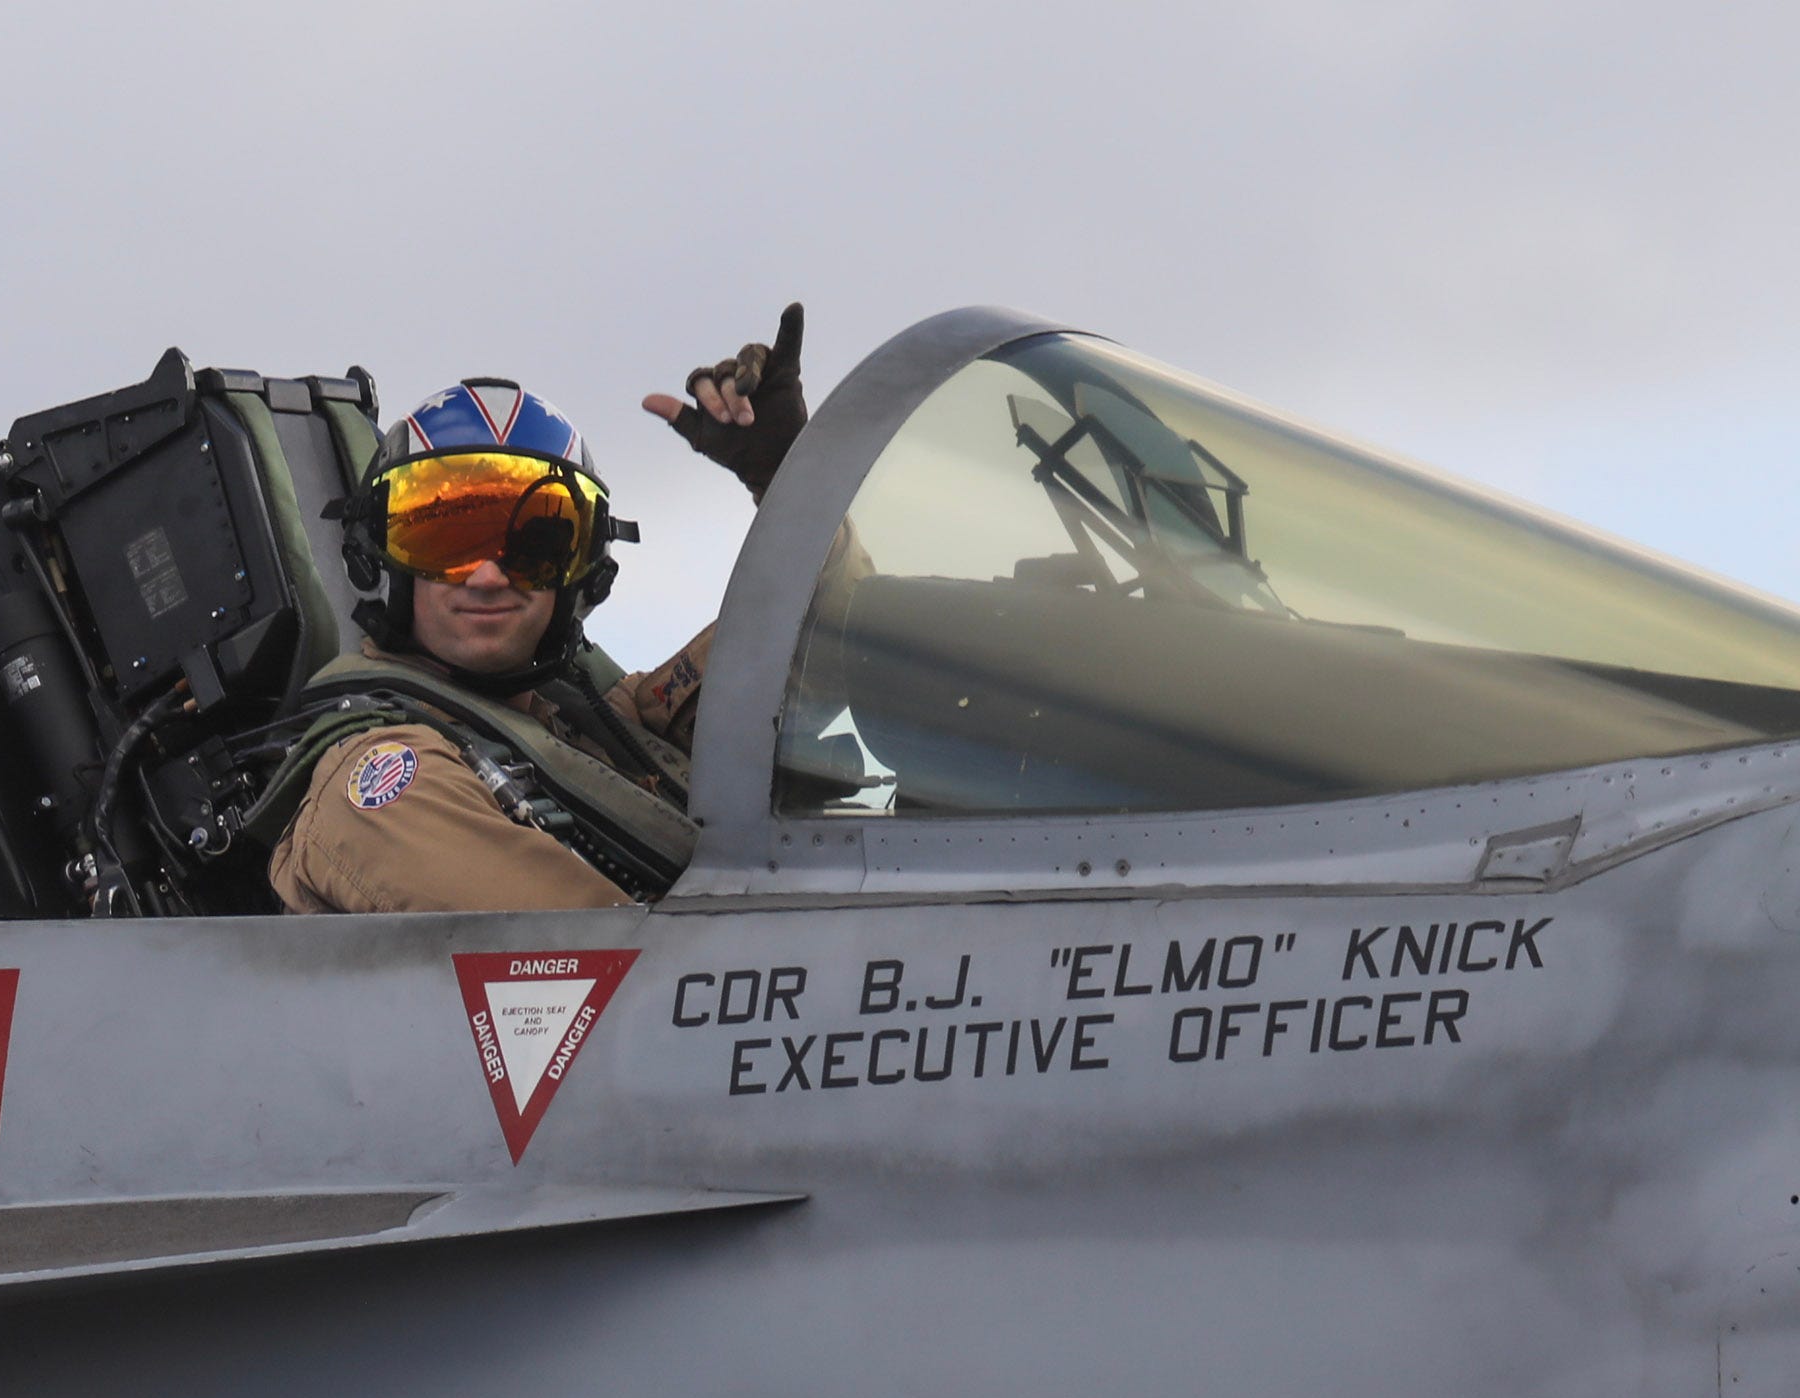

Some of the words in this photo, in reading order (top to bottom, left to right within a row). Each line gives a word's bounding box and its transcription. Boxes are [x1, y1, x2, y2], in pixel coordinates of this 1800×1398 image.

[509, 958, 579, 975] DANGER
[672, 966, 806, 1028] CDR
[859, 955, 983, 1015] B.J.
[1050, 933, 1296, 1000] "ELMO"
[1342, 918, 1555, 981] KNICK
[502, 1007, 543, 1016] EJECTION
[546, 1006, 567, 1015] SEAT
[514, 1027, 550, 1037] CANOPY
[524, 1017, 542, 1026] AND
[472, 1010, 505, 1083] DANGER
[548, 1005, 596, 1080] DANGER
[728, 1013, 1115, 1096] EXECUTIVE
[1168, 989, 1470, 1064] OFFICER
